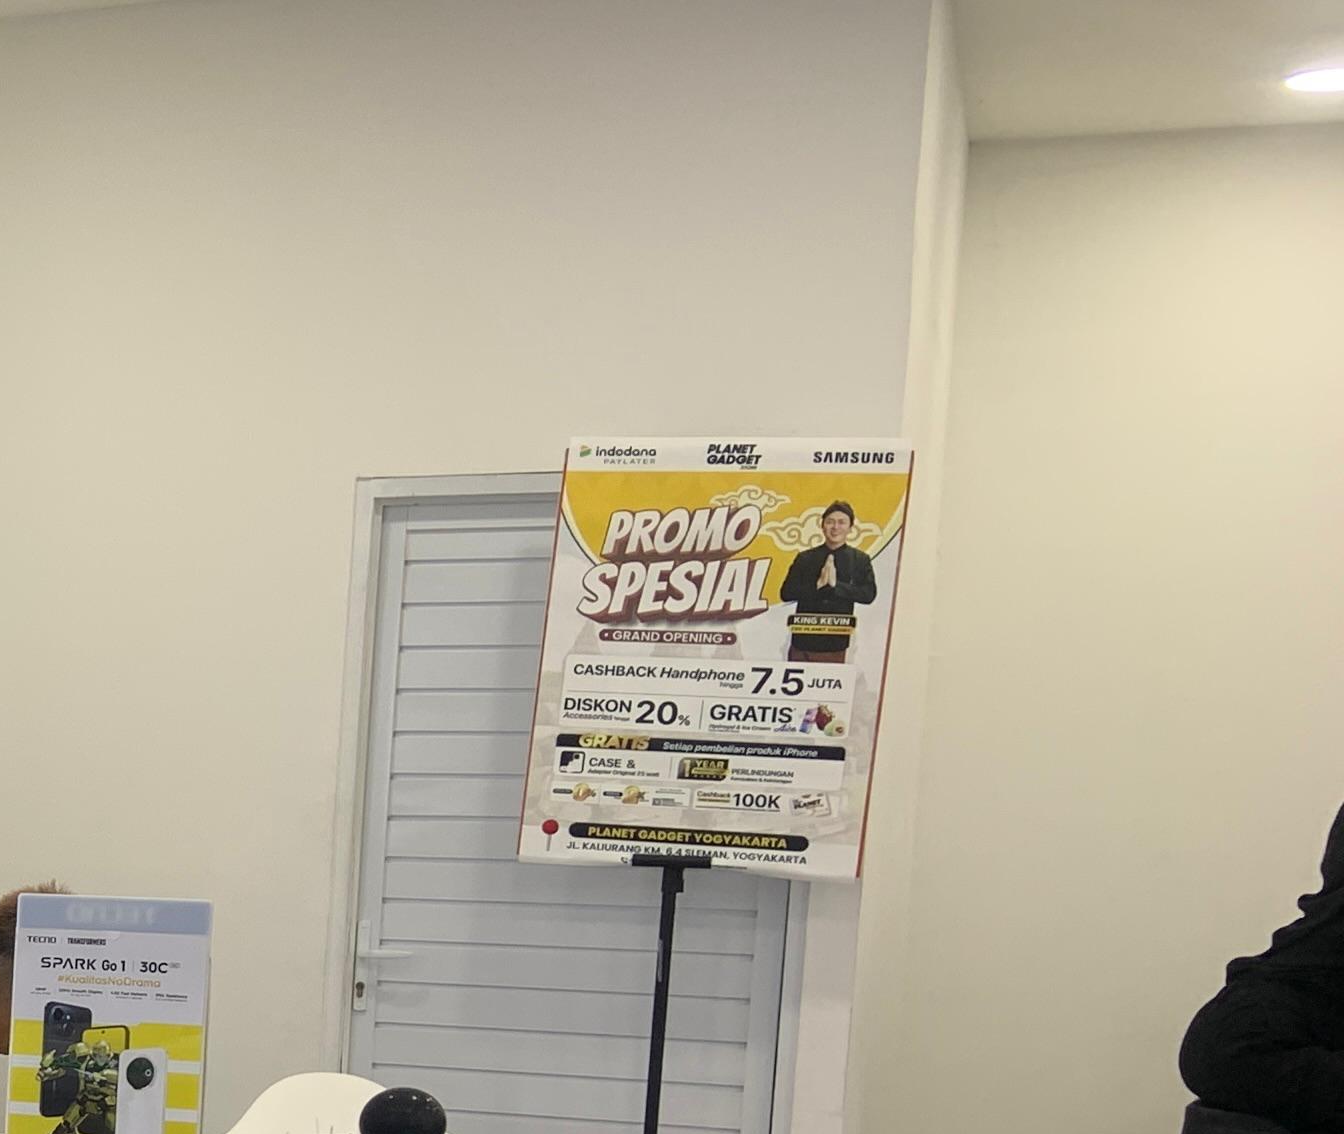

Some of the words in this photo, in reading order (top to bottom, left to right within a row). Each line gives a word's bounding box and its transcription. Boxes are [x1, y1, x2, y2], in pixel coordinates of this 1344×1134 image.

[596, 446, 657, 457] indodana
[707, 444, 757, 454] PLANET
[706, 455, 762, 464] GADGET
[813, 451, 895, 464] SAMSUNG
[603, 504, 763, 556] PROMO
[577, 558, 773, 618] SPESIAL
[793, 616, 817, 625] KING
[820, 617, 850, 625] KEVIN
[613, 630, 660, 642] GRAND
[663, 632, 723, 644] OPENING
[573, 663, 657, 678] CASHBACK
[660, 666, 745, 682] Handphone
[751, 667, 804, 696] 7.5
[808, 678, 843, 690] JUTA
[563, 697, 632, 713] DISKON
[563, 712, 613, 721] Accessories
[578, 732, 650, 750] GRATIS
[663, 741, 693, 752] Setiap
[746, 746, 781, 756] produk
[783, 748, 818, 757] iPhone
[589, 757, 622, 768] CASE
[626, 759, 636, 769] &
[694, 760, 725, 769] YEAR
[733, 793, 781, 809] 100K
[588, 826, 637, 839] PLANET
[638, 829, 692, 843] GADGET
[693, 833, 787, 849] YOGYAKARTA
[733, 851, 807, 865] YOGYAKARTA
[27, 935, 57, 944] TECNO
[40, 956, 97, 971] SPARK
[101, 959, 117, 972] Go
[120, 960, 126, 972] 1
[140, 961, 169, 974] 30C
